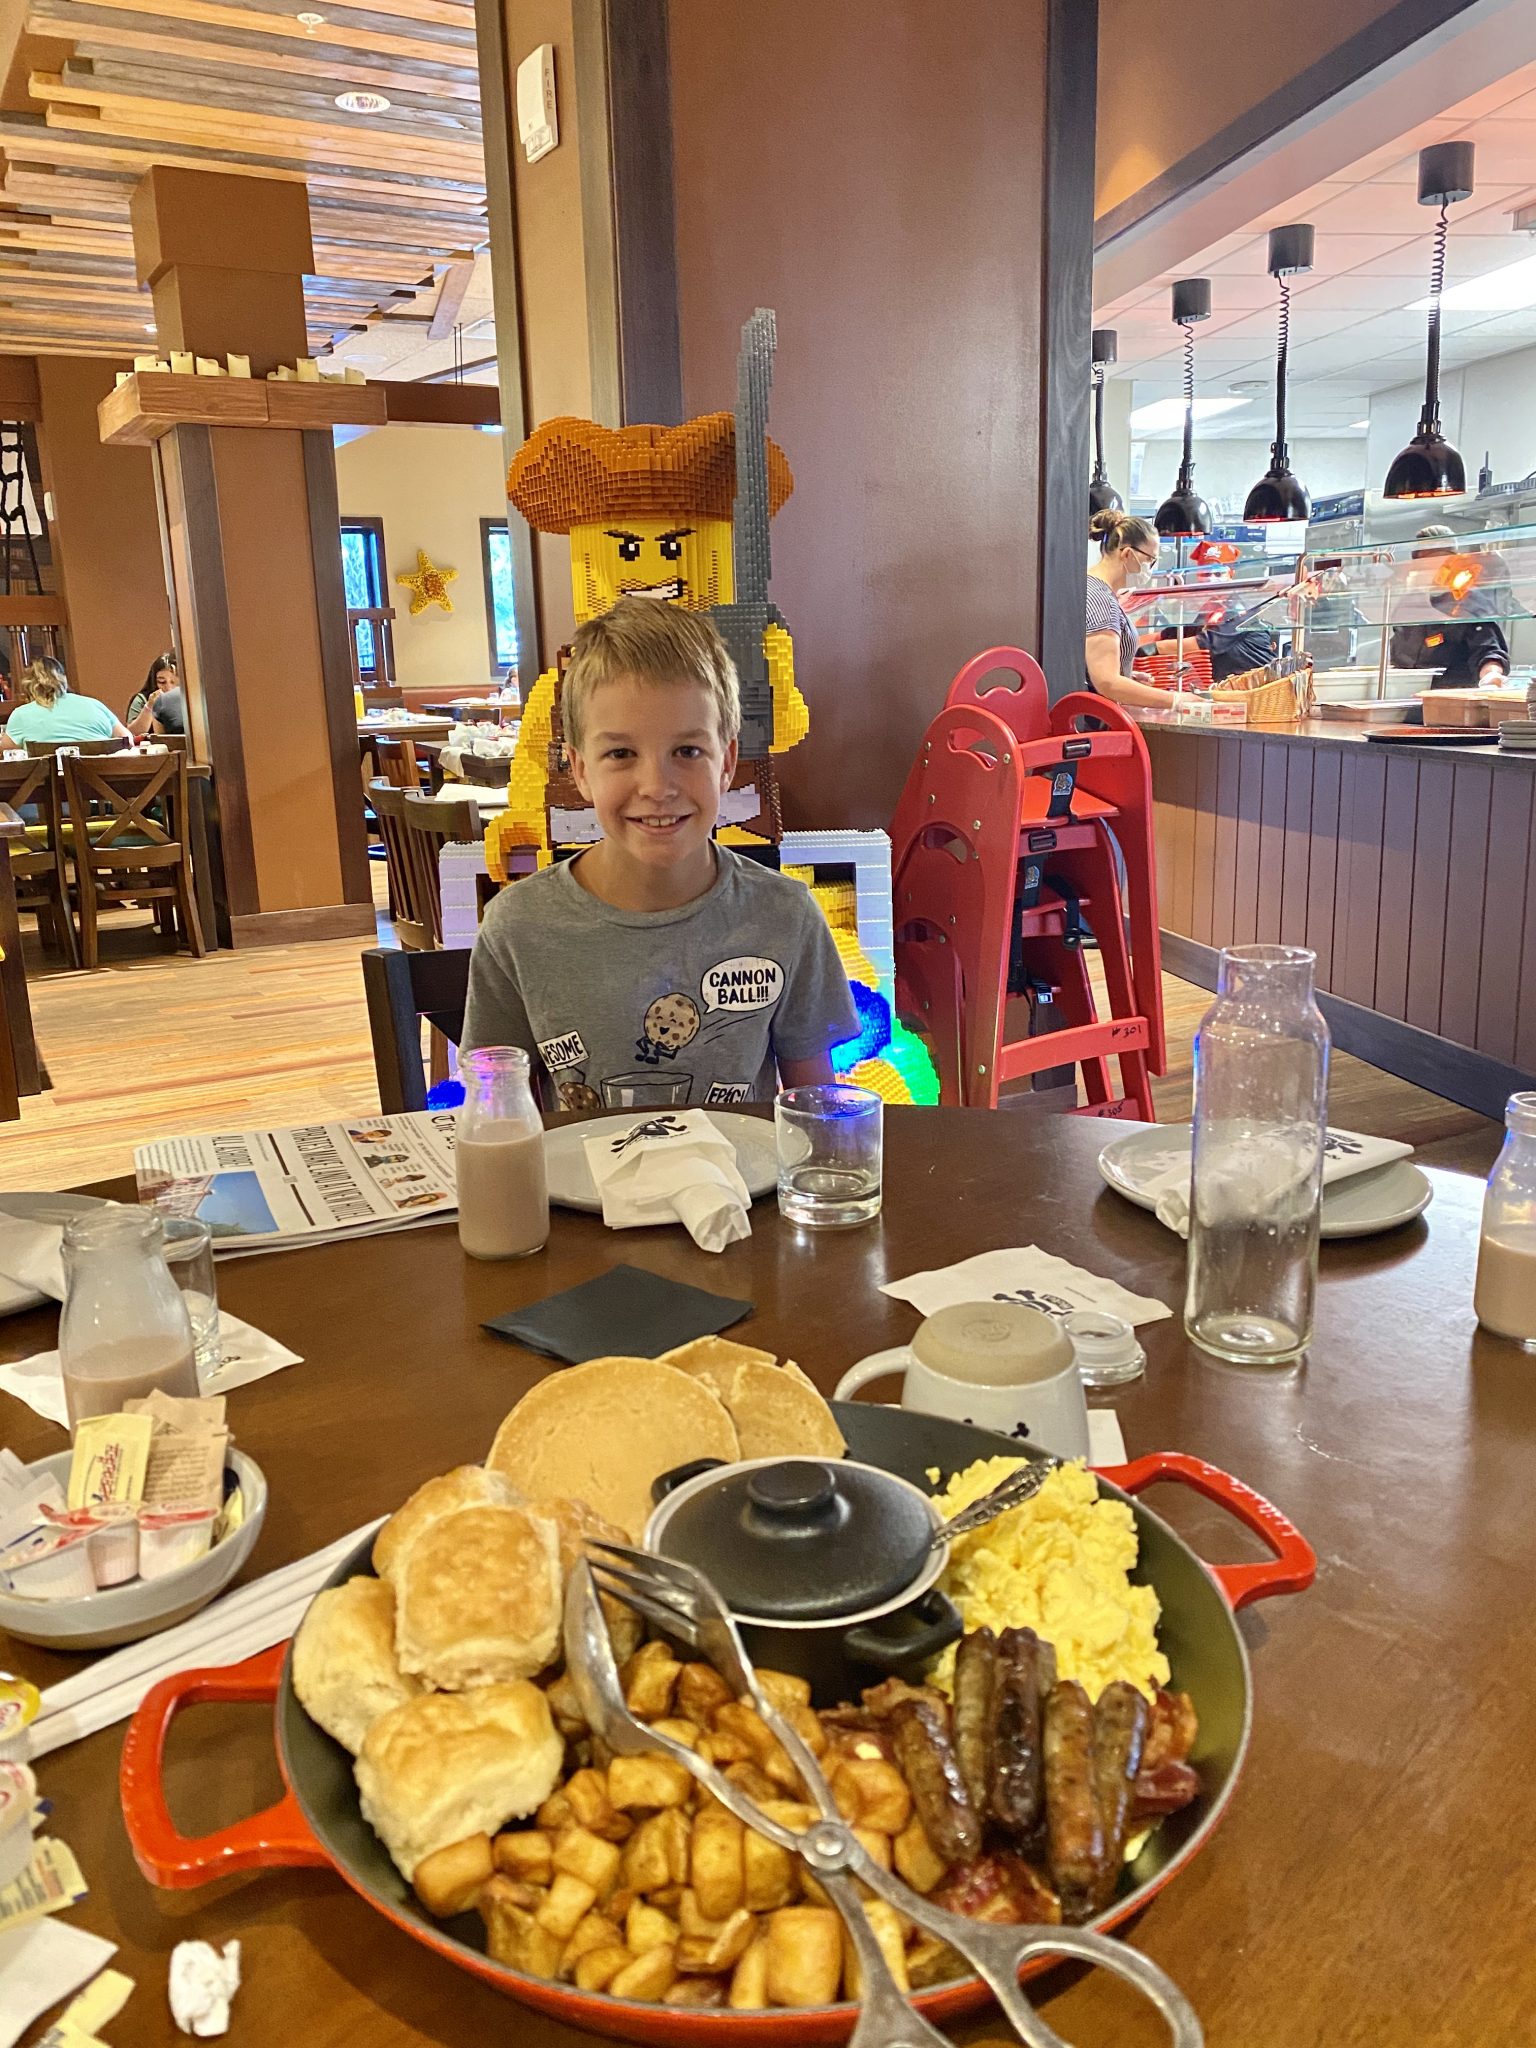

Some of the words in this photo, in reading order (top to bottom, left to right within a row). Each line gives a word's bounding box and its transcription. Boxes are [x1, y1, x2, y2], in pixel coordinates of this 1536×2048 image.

[544, 68, 553, 110] FIRE
[709, 967, 776, 987] CANNON
[718, 985, 769, 1004] BALL!!!
[289, 1125, 335, 1152] PIRATES
